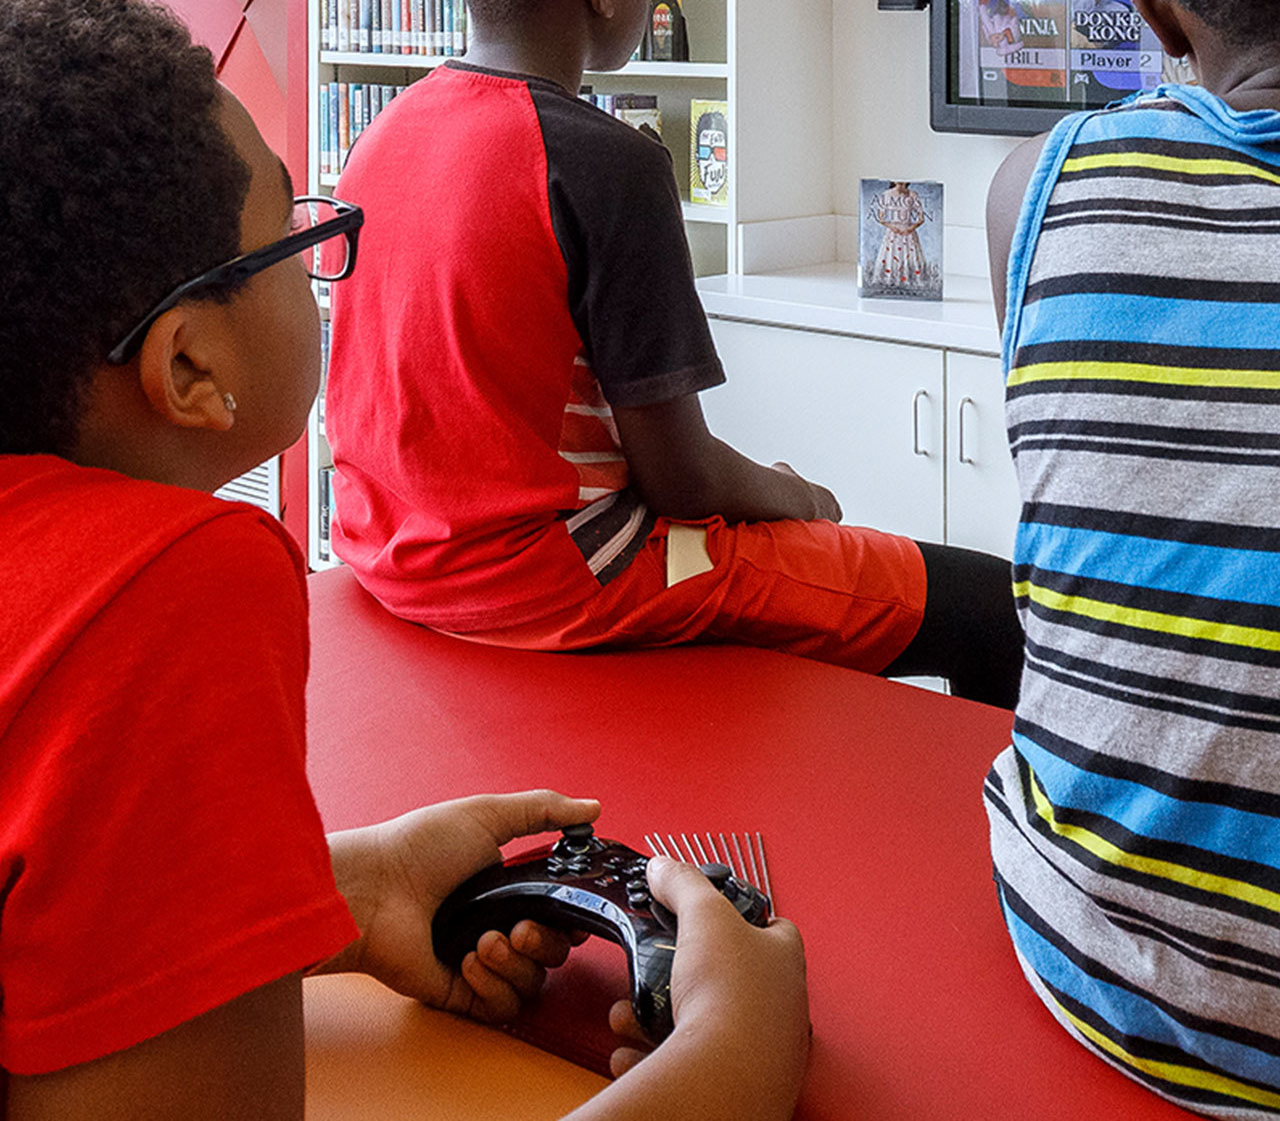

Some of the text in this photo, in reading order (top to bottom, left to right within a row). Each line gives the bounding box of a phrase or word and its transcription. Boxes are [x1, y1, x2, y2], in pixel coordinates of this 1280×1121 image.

[1074, 11, 1143, 29] DONKE
[1087, 25, 1141, 42] KONG
[1079, 51, 1153, 70] Player 2
